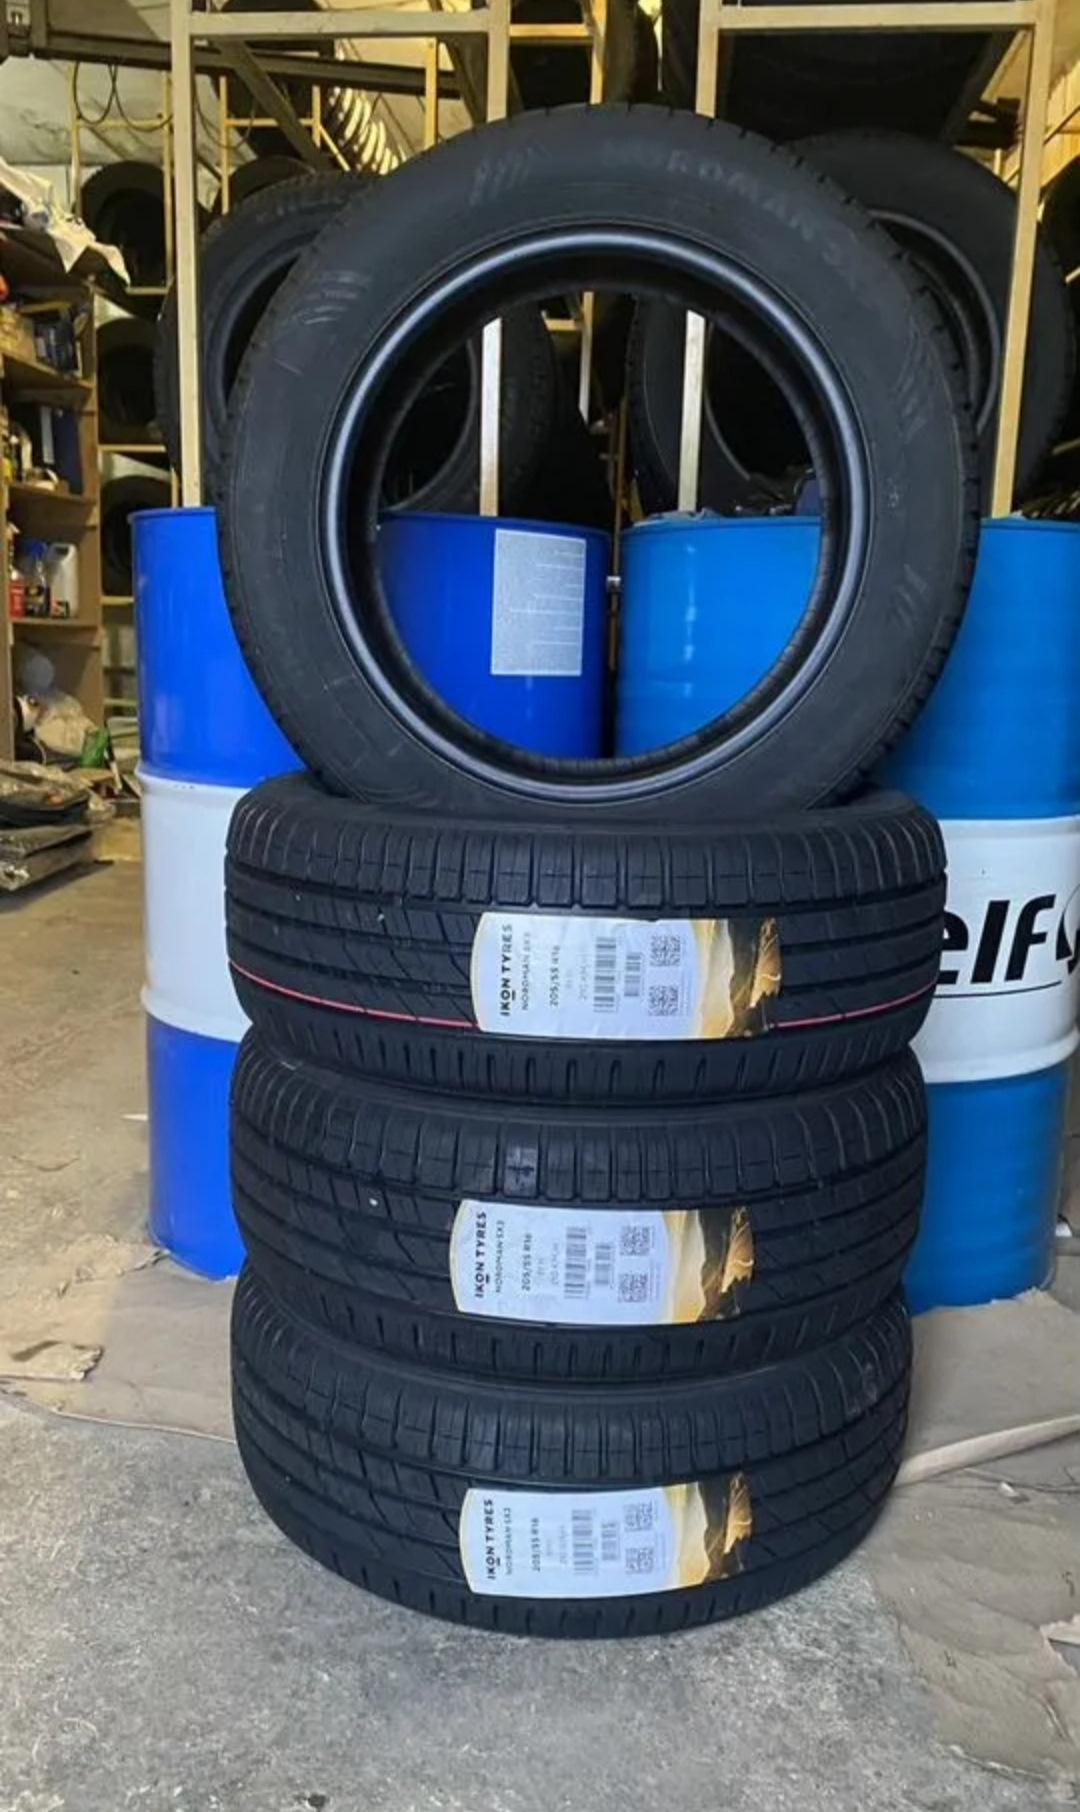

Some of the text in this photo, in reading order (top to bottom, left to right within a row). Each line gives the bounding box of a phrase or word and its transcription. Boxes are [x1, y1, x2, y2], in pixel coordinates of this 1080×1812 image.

[938, 893, 1056, 985] elf
[500, 924, 515, 1016] IKON TYRES
[521, 954, 531, 1011] NORDMAN
[549, 967, 560, 1006] 205/55
[475, 1212, 490, 1298] IKON TYRES
[495, 1241, 503, 1293] NORDMAN
[522, 1254, 533, 1291] 205/55
[484, 1499, 500, 1580] IKON TYRES
[504, 1527, 513, 1575] NORDMAN
[531, 1538, 541, 1572] 205/55
